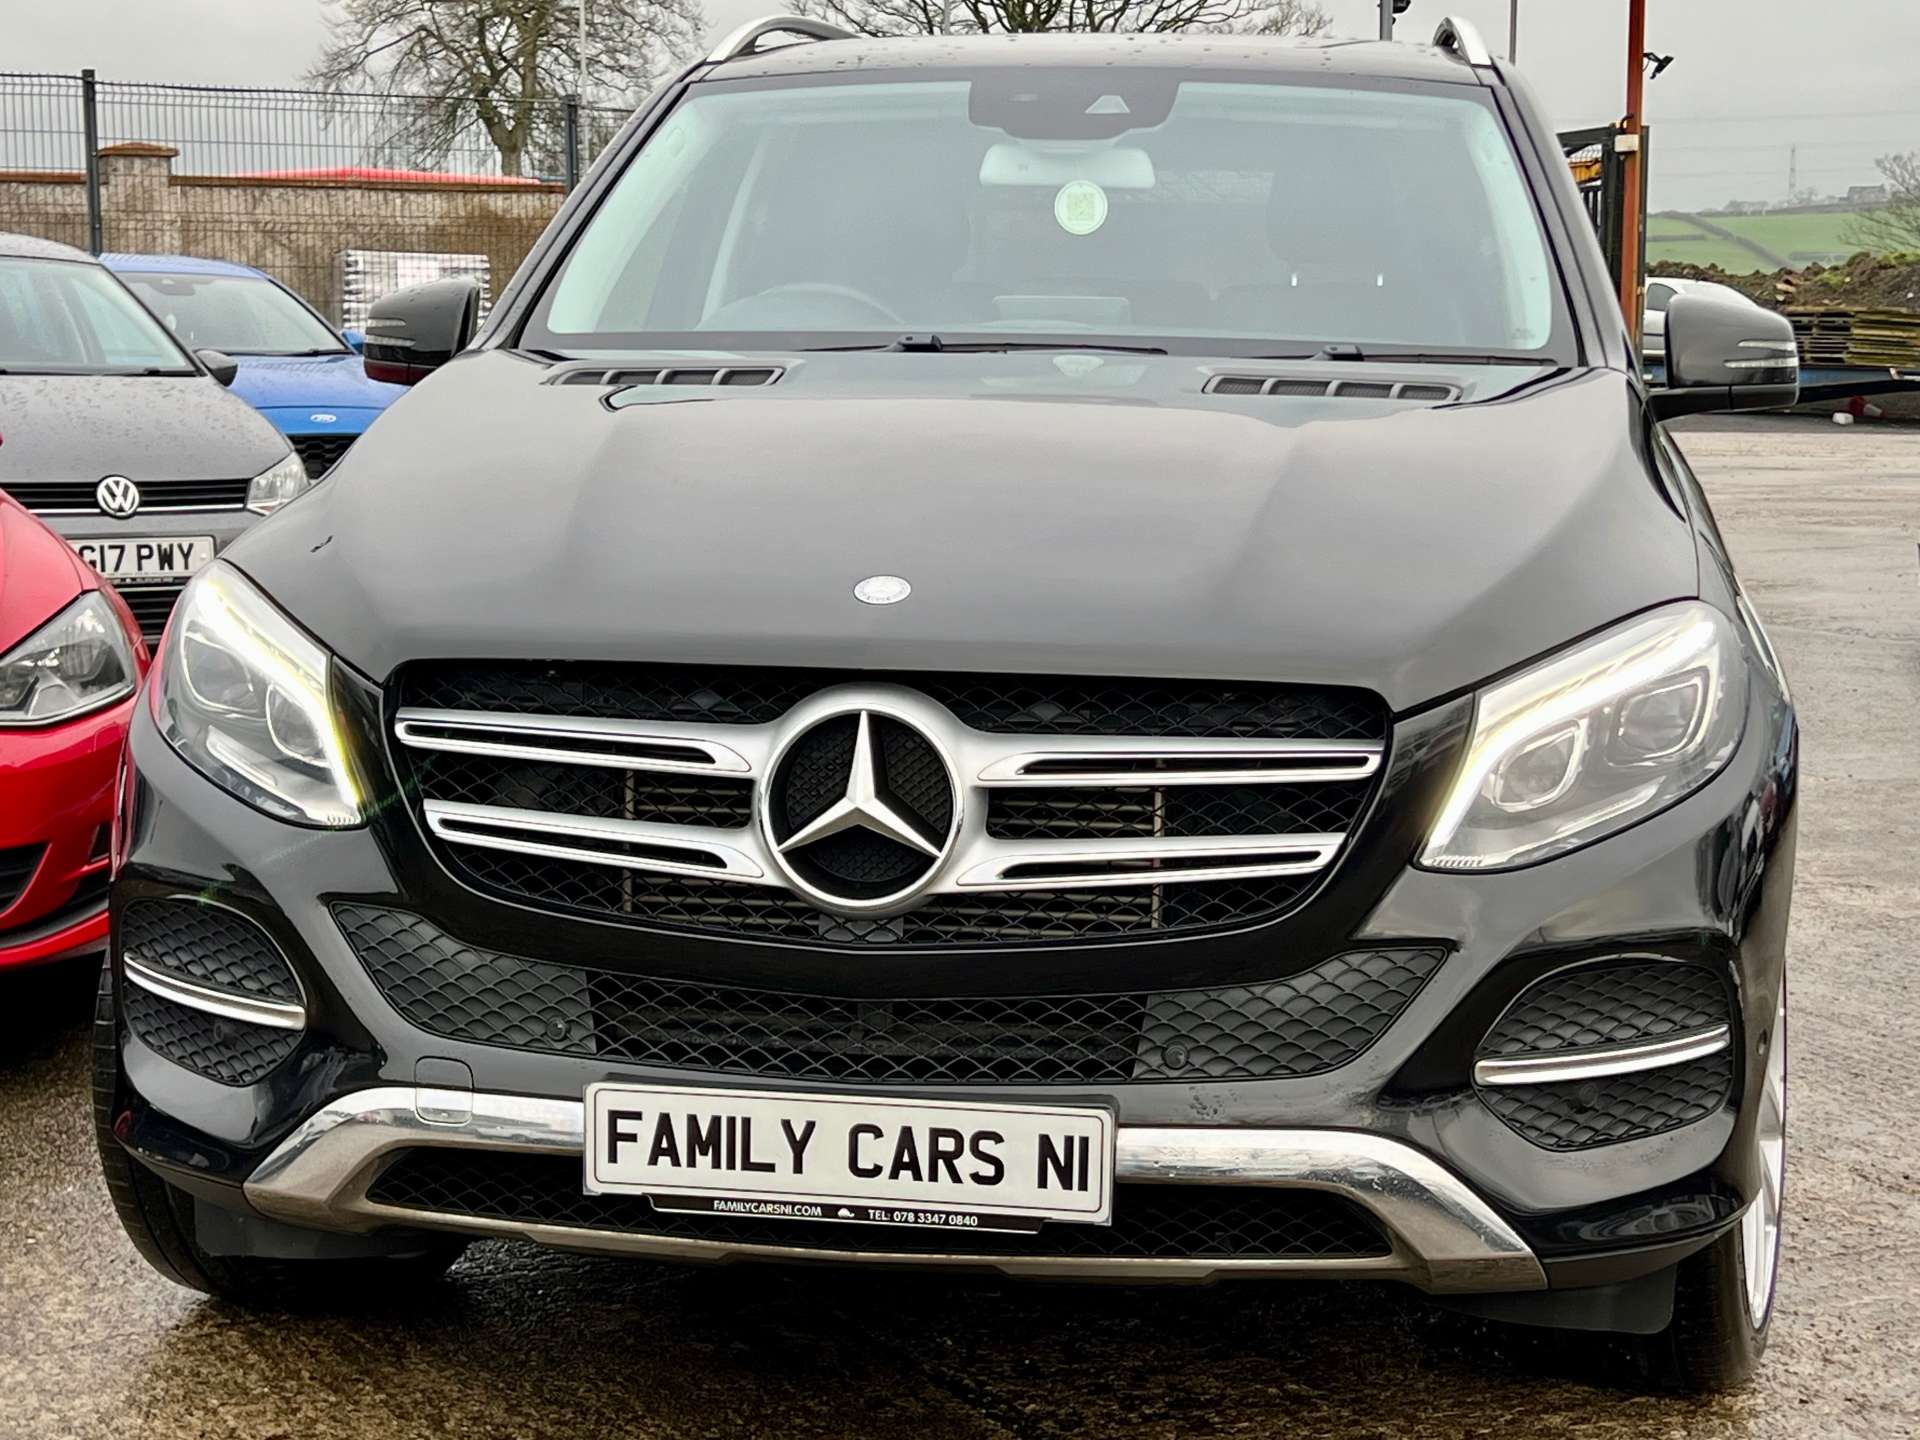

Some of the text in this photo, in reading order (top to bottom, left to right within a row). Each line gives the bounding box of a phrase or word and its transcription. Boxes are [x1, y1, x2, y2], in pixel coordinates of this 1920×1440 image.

[136, 543, 194, 571] PWY
[606, 1110, 1090, 1192] FAMILY CARS NI
[713, 1200, 822, 1216] FAMILYCARSNI.COM
[893, 1211, 915, 1223] 078
[917, 1212, 946, 1225] 3347
[948, 1214, 978, 1226] 0840
